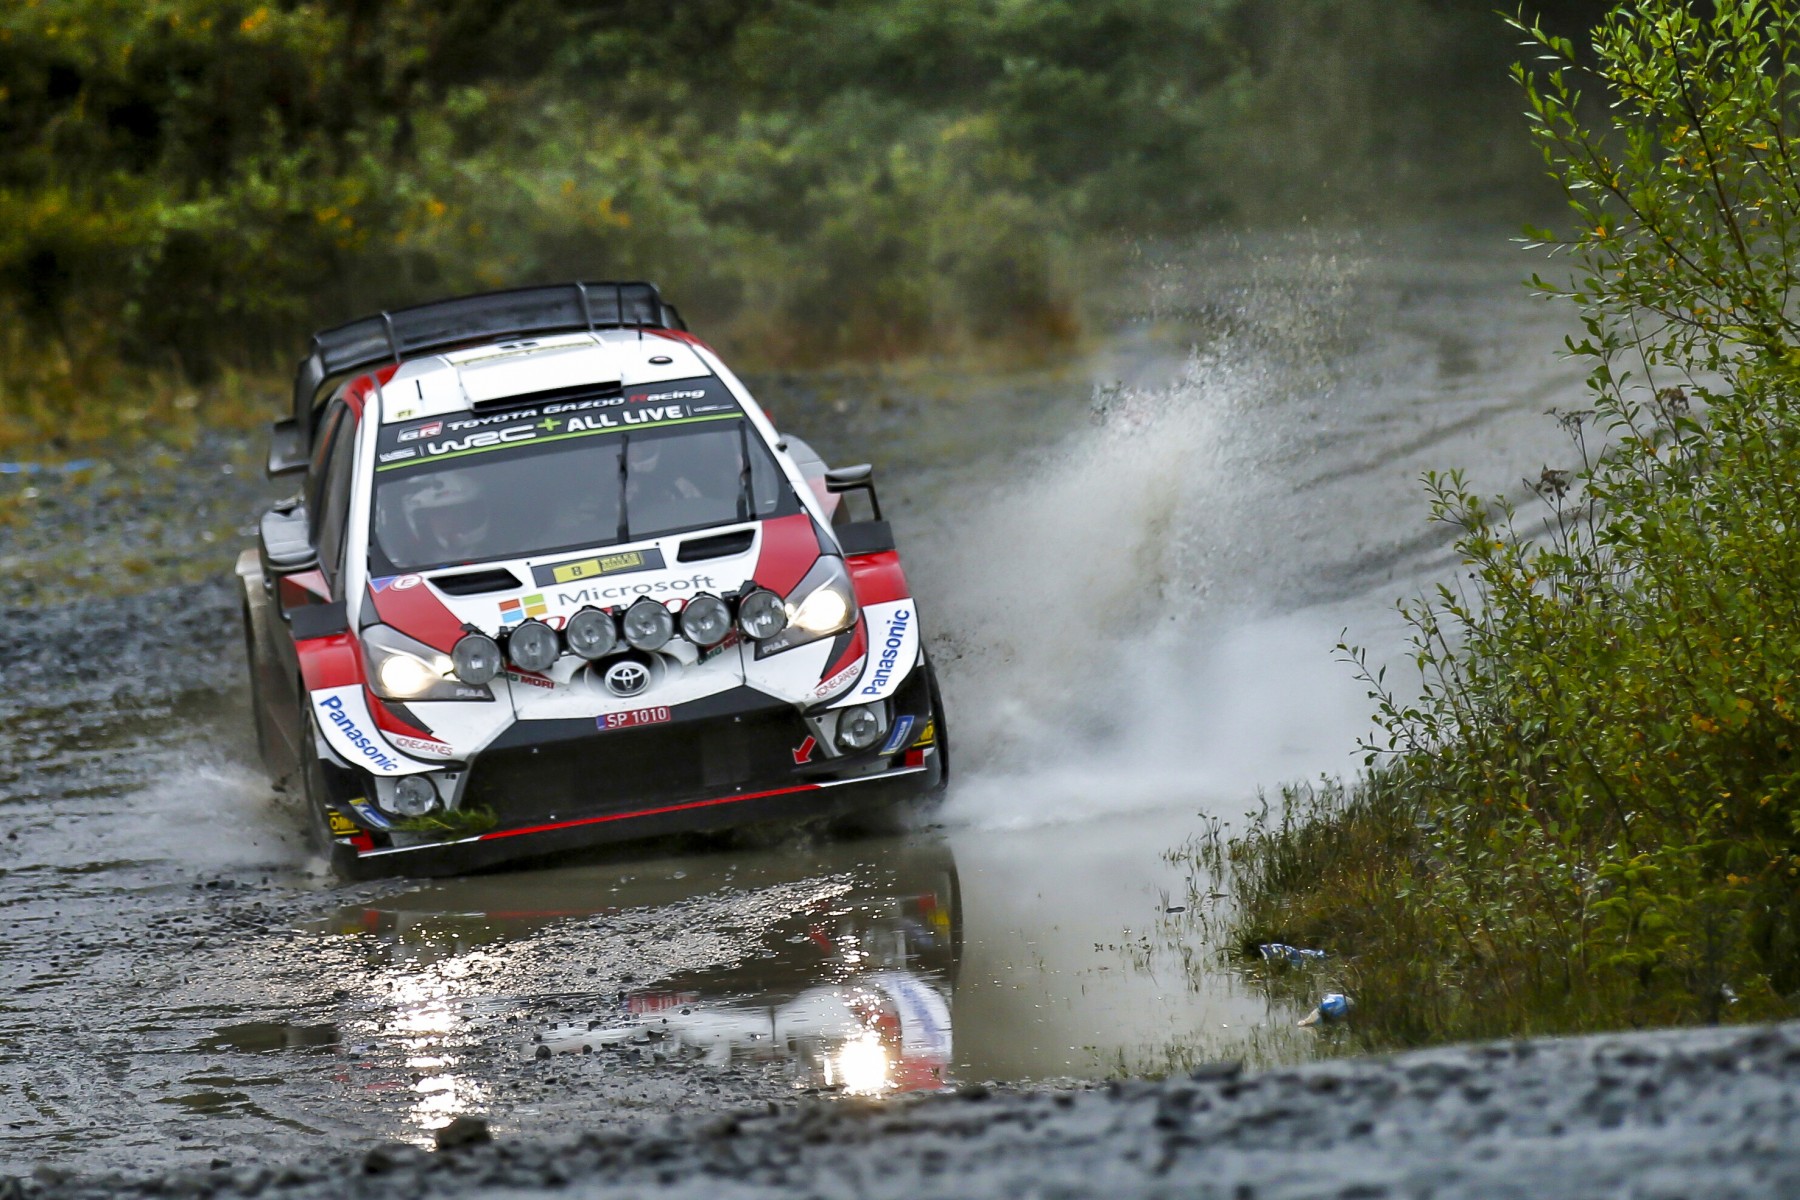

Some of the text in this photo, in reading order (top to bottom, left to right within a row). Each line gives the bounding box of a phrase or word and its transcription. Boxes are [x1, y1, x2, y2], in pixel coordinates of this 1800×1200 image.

[399, 422, 443, 442] GR
[447, 409, 537, 431] TOYOTA
[543, 397, 625, 415] GAZOO
[567, 414, 618, 432] ALL
[622, 404, 683, 424] LIVE
[557, 573, 716, 607] Microsoft
[861, 609, 910, 696] Panasonic
[455, 688, 485, 698] PIAA
[520, 675, 555, 690] MORI
[606, 707, 667, 728] SP 1010
[319, 695, 399, 772] Panasonic
